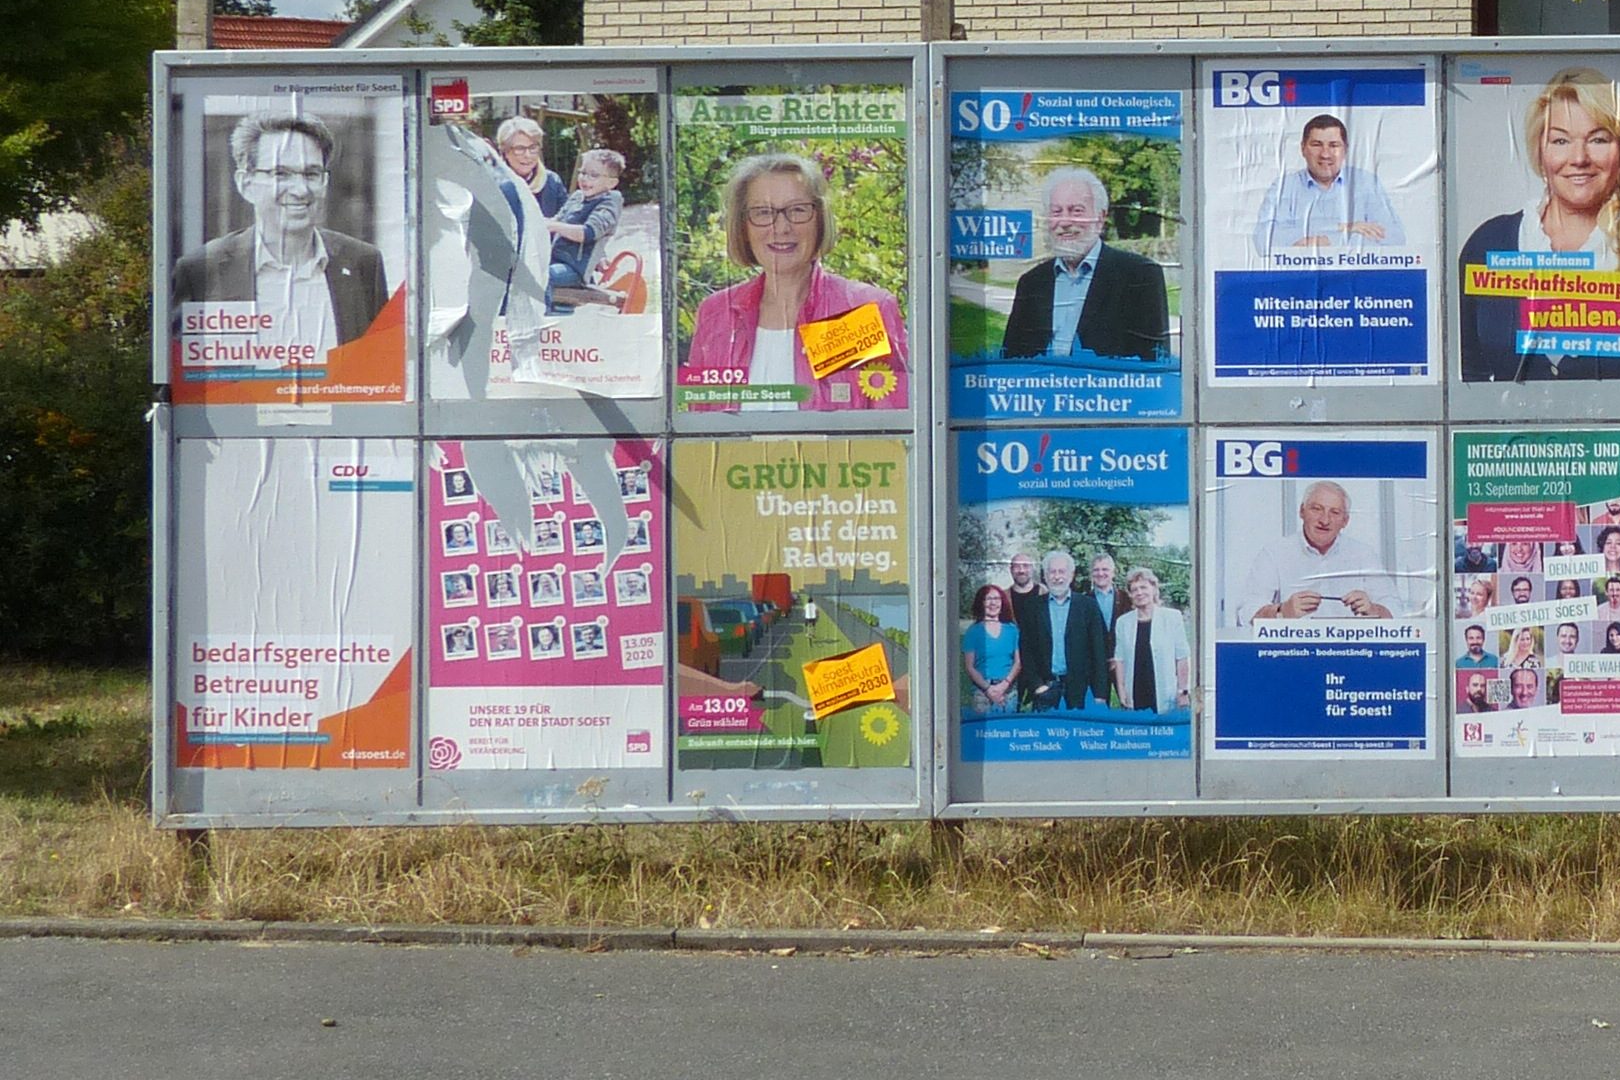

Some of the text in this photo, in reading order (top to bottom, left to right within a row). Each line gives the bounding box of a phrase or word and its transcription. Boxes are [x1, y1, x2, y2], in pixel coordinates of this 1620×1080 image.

[274, 82, 371, 96] Ihr Bürgermeister für
[434, 99, 464, 112] SPD
[690, 97, 897, 122] Anne Richter
[1037, 94, 1176, 110] Sozial und Oekologisch.
[1028, 111, 1121, 127] Soest kann
[750, 124, 896, 137] Bürgermeisterkandidatin
[955, 216, 1021, 242] Willy
[1274, 254, 1334, 266] Thomas
[1490, 255, 1591, 267] Kerstin Hofmann
[1254, 296, 1413, 311] Miteinander können
[187, 309, 272, 331] sichere
[1254, 314, 1414, 328] WIR Brücken bauen.
[857, 330, 886, 352] 2030
[1521, 334, 1557, 350] Jetzt
[1561, 336, 1592, 351] erst
[188, 340, 316, 365] Schulwege
[702, 369, 747, 384] 13.09.
[964, 373, 1162, 392] Bürgermeisterkandidat
[685, 389, 791, 400] Das Beste für Soest
[989, 394, 1133, 416] Willy Fischer
[1467, 443, 1620, 459] INTEGRATIONSRATS- UND
[1052, 448, 1169, 472] für Soest
[332, 466, 368, 477] CDU
[726, 458, 897, 490] GRÜN IST
[1467, 461, 1619, 477] KOMMUNALWAHLEN NRW
[1018, 476, 1134, 491] sozial und oekologisch
[1467, 482, 1572, 497] 13. September 2020
[757, 491, 897, 517] Überholen
[788, 520, 897, 543] auf dem
[783, 546, 897, 572] Radweg.
[1549, 560, 1599, 577] DEIN LAND
[1491, 604, 1589, 626] DEINE STADT SOEST
[1257, 626, 1321, 639] Andreas
[624, 636, 656, 648] 13.09.
[192, 642, 391, 669] bedarfsgerechte
[626, 649, 655, 662] 2020
[1258, 648, 1420, 660] pragmatisch bodenständig engagiert
[1568, 659, 1596, 674] DEINE
[859, 673, 889, 695] 2030
[1325, 673, 1345, 685] Ihr
[193, 674, 318, 700] Betreuung
[1325, 689, 1423, 704] Bürgermeister
[470, 702, 551, 716] UNSERE 19 FÜR
[704, 698, 750, 713] 13.09.
[1325, 704, 1392, 717] für Soest!
[192, 706, 313, 727] für Kinder
[470, 716, 611, 728] DEN RAT DER STADT SOEST
[688, 716, 749, 728] Grün wählen!
[1046, 725, 1148, 741] Willy Fischer Martina
[1009, 739, 1108, 752] Sven Walter
[341, 749, 406, 760] cdusoest.de
